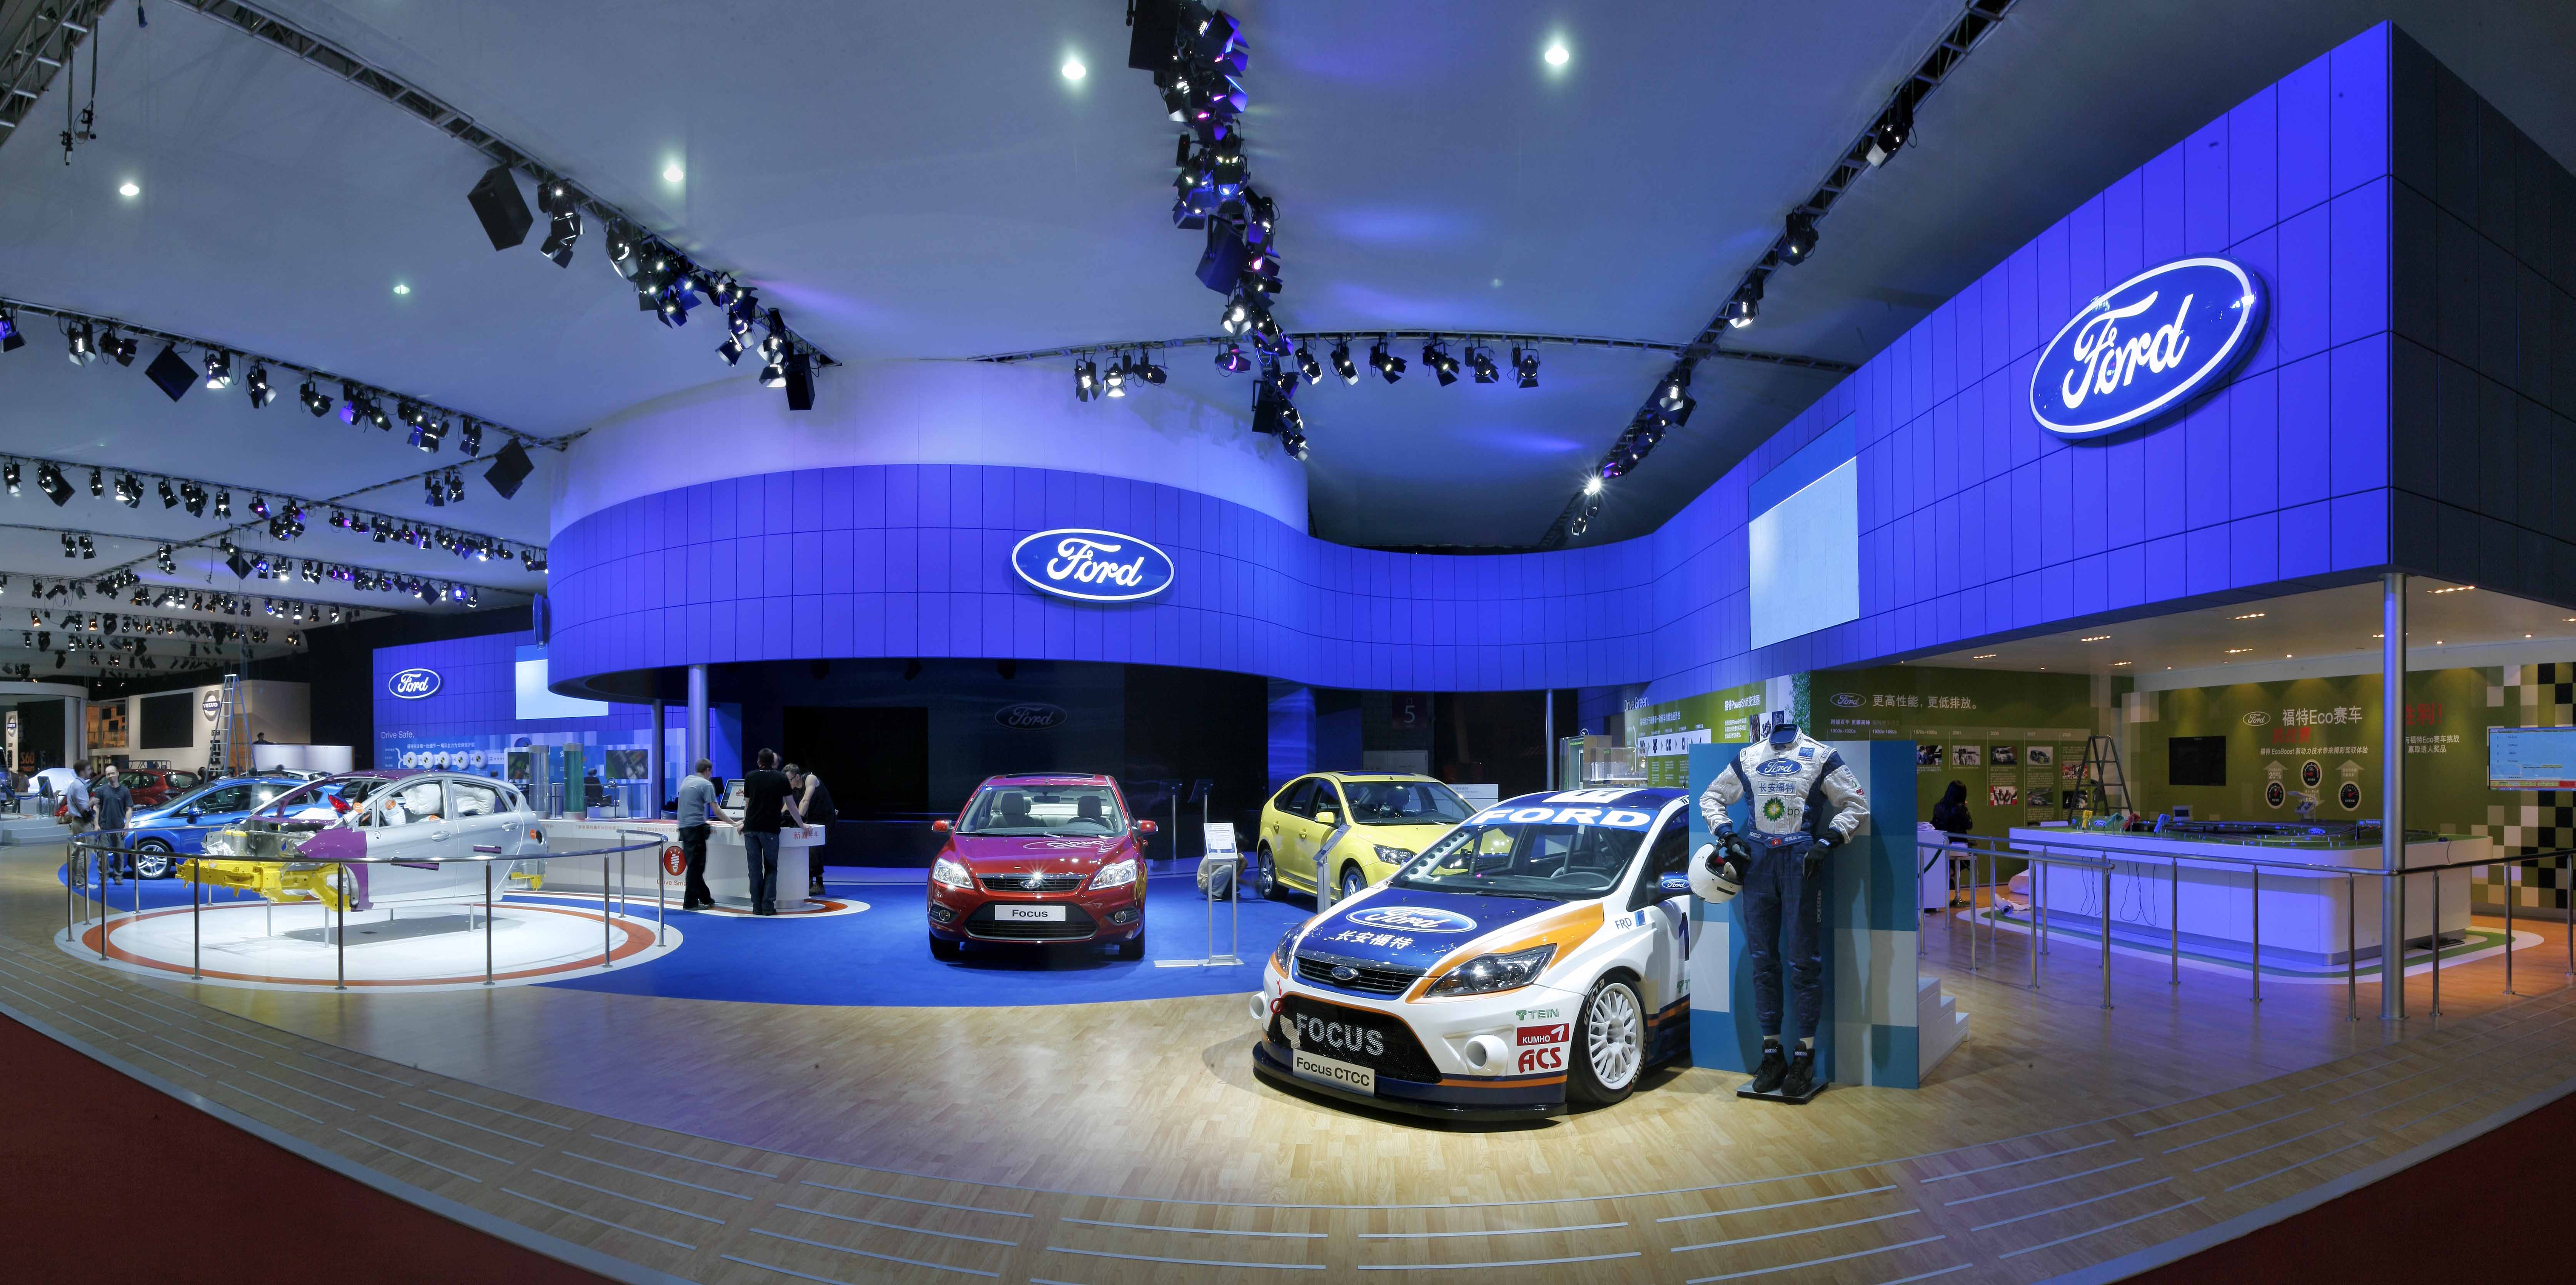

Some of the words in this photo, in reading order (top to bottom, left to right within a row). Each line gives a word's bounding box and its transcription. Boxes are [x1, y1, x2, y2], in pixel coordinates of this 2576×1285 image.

[2062, 291, 2193, 408] Ford
[1047, 538, 1144, 587] Ford
[397, 673, 429, 693] Ford
[1624, 700, 1634, 711] Drive
[1837, 694, 1859, 705] Ford
[1008, 707, 1053, 726] Ford
[1404, 705, 1416, 723] 5
[2247, 713, 2266, 724] Ford
[2282, 705, 2363, 726] 福特Eco赛车
[1765, 761, 1792, 773] Ford
[1578, 789, 1617, 797] 11
[1759, 782, 1795, 793] 长安福特
[1471, 808, 1651, 827] FORD
[1787, 807, 1800, 817] bp
[1667, 880, 1686, 888] Ford
[1012, 909, 1048, 917] Focus
[1364, 909, 1452, 928] Ford
[1615, 918, 1632, 930] FRD
[1335, 930, 1414, 949] 长安福特
[1528, 1008, 1559, 1019] TEIN
[1296, 1012, 1384, 1056] FOCUS
[1522, 1035, 1550, 1044] KUMHO
[1518, 1047, 1562, 1074] ACS
[1296, 1057, 1332, 1077] Focus
[1334, 1067, 1370, 1087] CTCC
